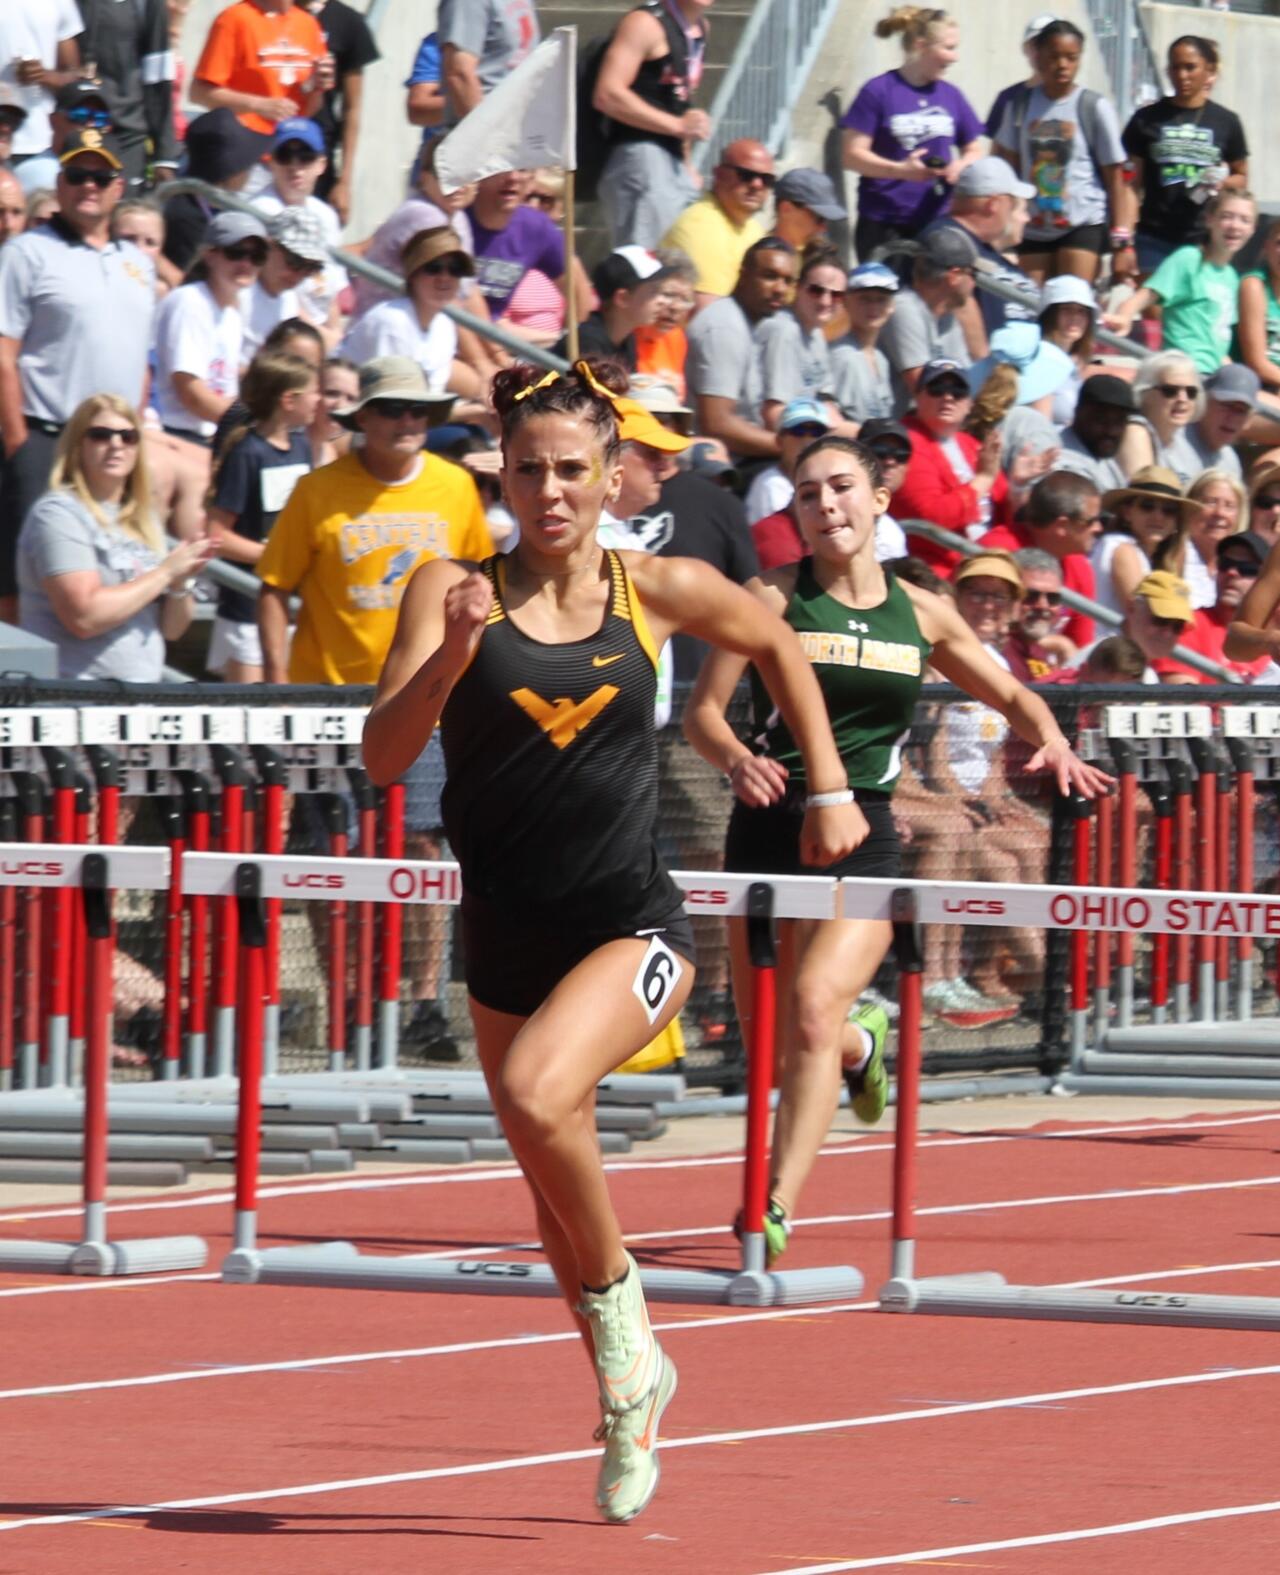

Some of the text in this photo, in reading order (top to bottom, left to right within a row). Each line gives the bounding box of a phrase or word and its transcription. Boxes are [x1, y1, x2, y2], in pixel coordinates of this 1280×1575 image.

[1, 862, 63, 876] UCS
[284, 867, 458, 900] UCS OHI
[684, 889, 728, 904] CS
[943, 899, 1006, 915] UCS
[1050, 893, 1151, 929] OHIO
[642, 950, 674, 1010] 6
[457, 1262, 531, 1277] UCS
[1116, 1293, 1187, 1309] UCS
